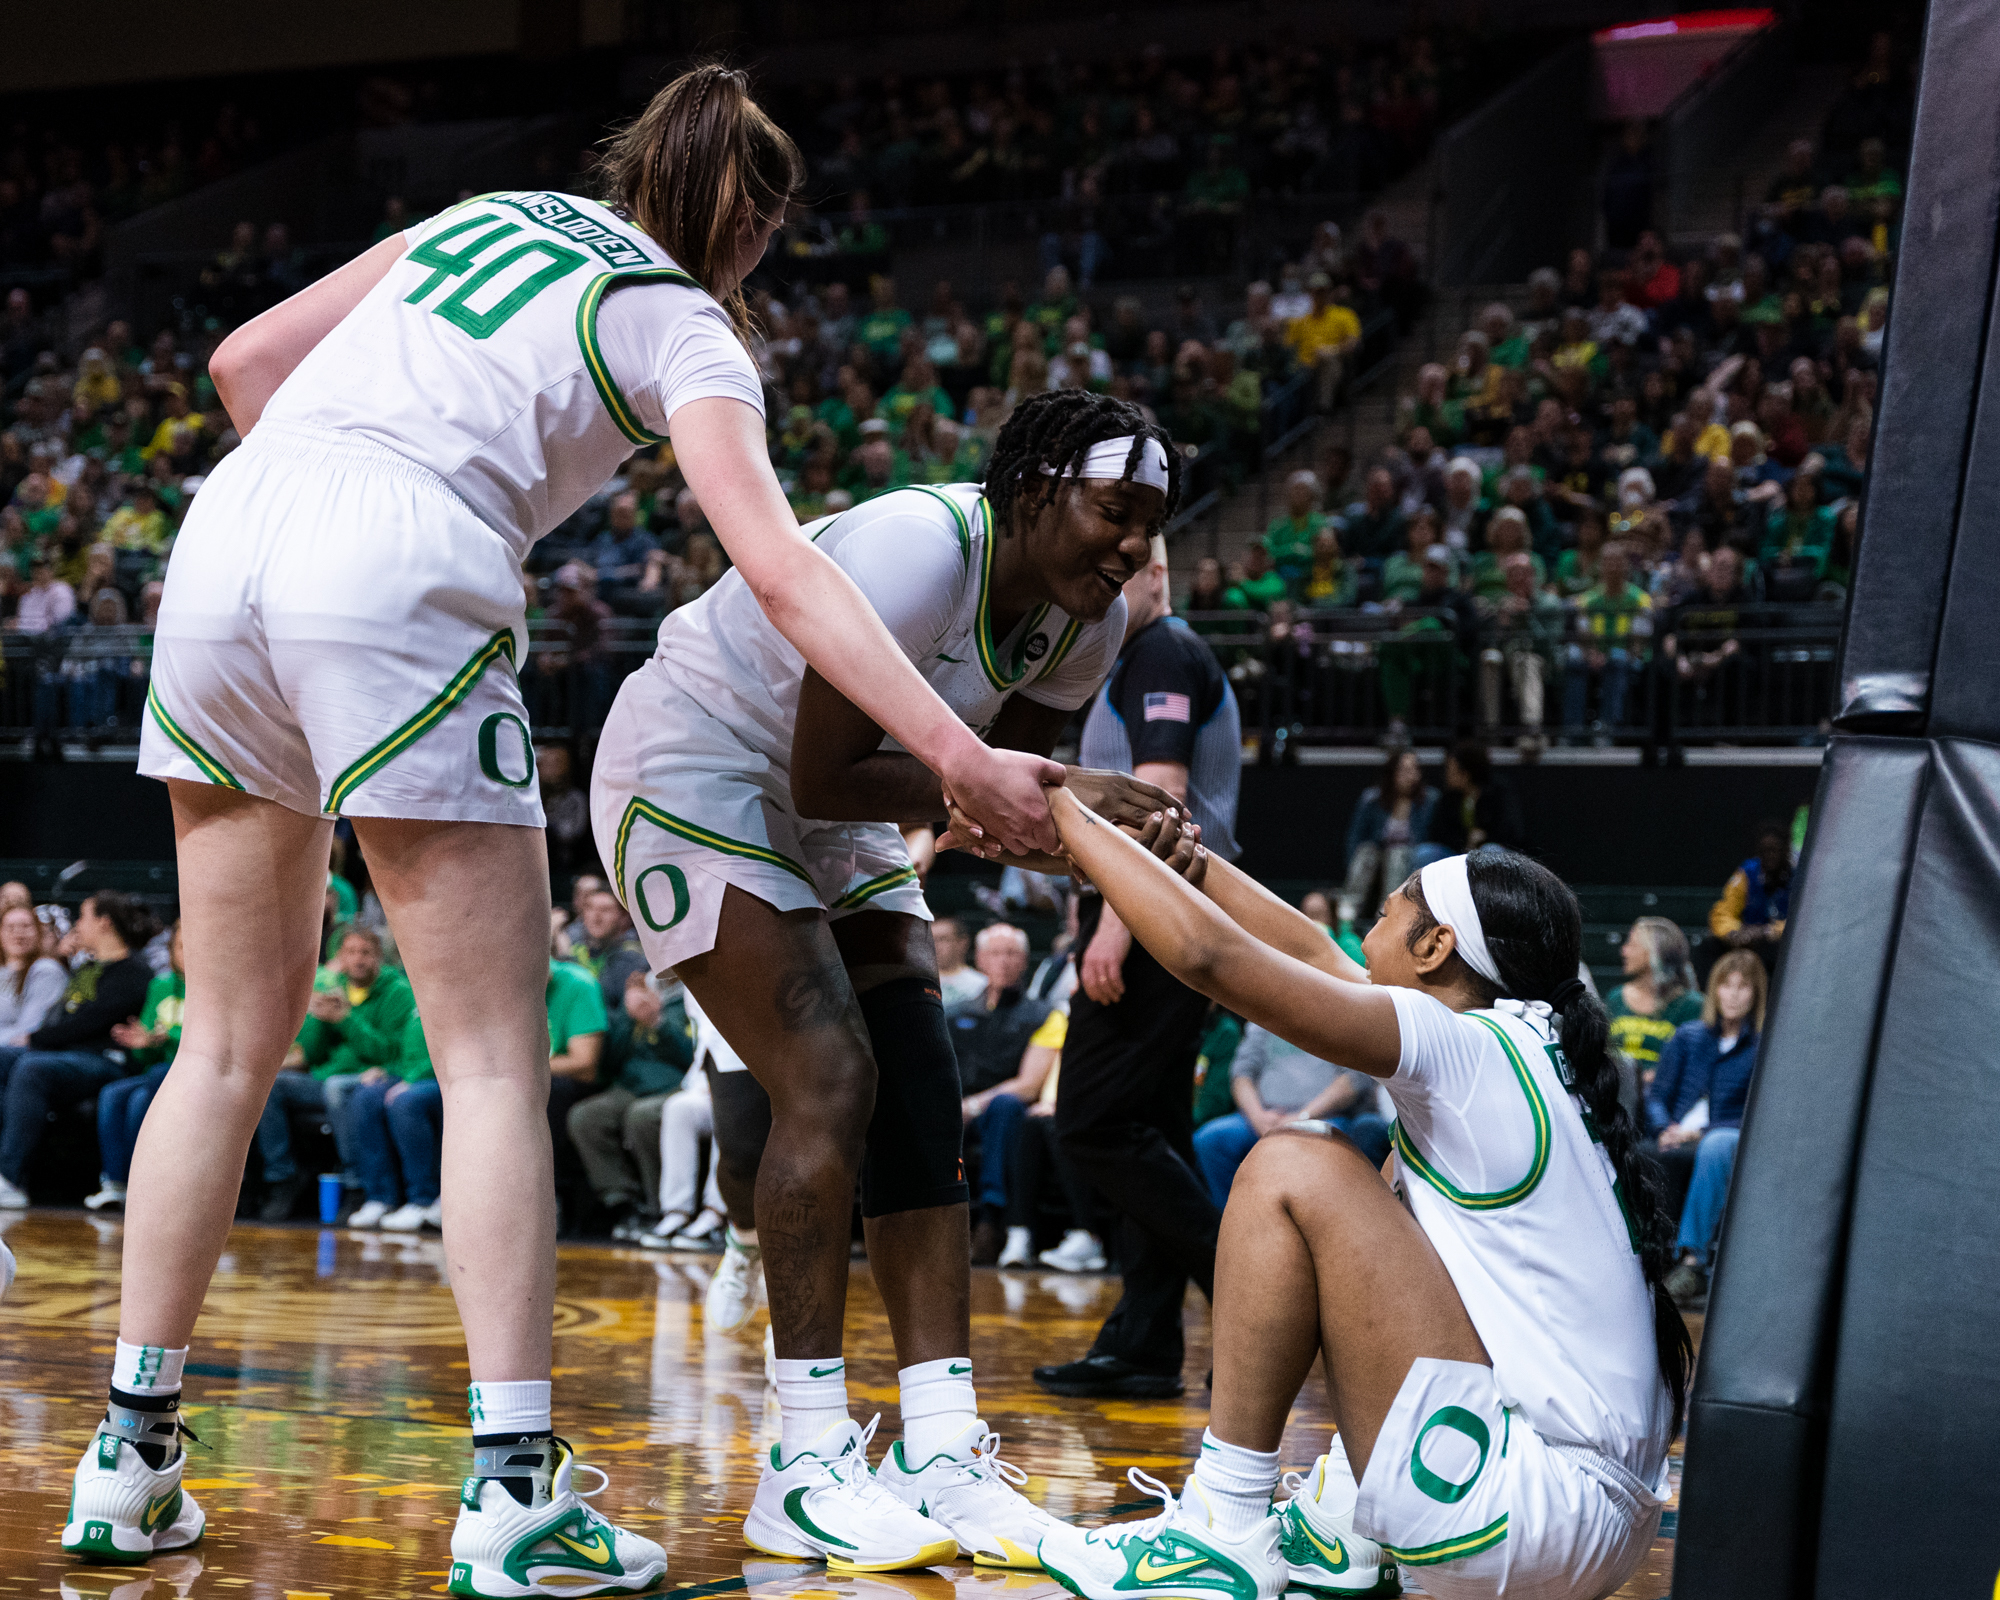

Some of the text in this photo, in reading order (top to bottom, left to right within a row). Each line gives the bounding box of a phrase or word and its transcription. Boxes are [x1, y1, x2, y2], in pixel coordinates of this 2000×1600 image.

[402, 212, 591, 340] 40
[477, 711, 535, 788] O
[635, 863, 691, 933] O
[102, 1435, 118, 1459] EASY
[1410, 1405, 1491, 1504] O
[463, 1477, 479, 1501] EASY
[89, 1526, 105, 1539] 07
[454, 1568, 466, 1581] 07
[1384, 1568, 1395, 1581] 07
